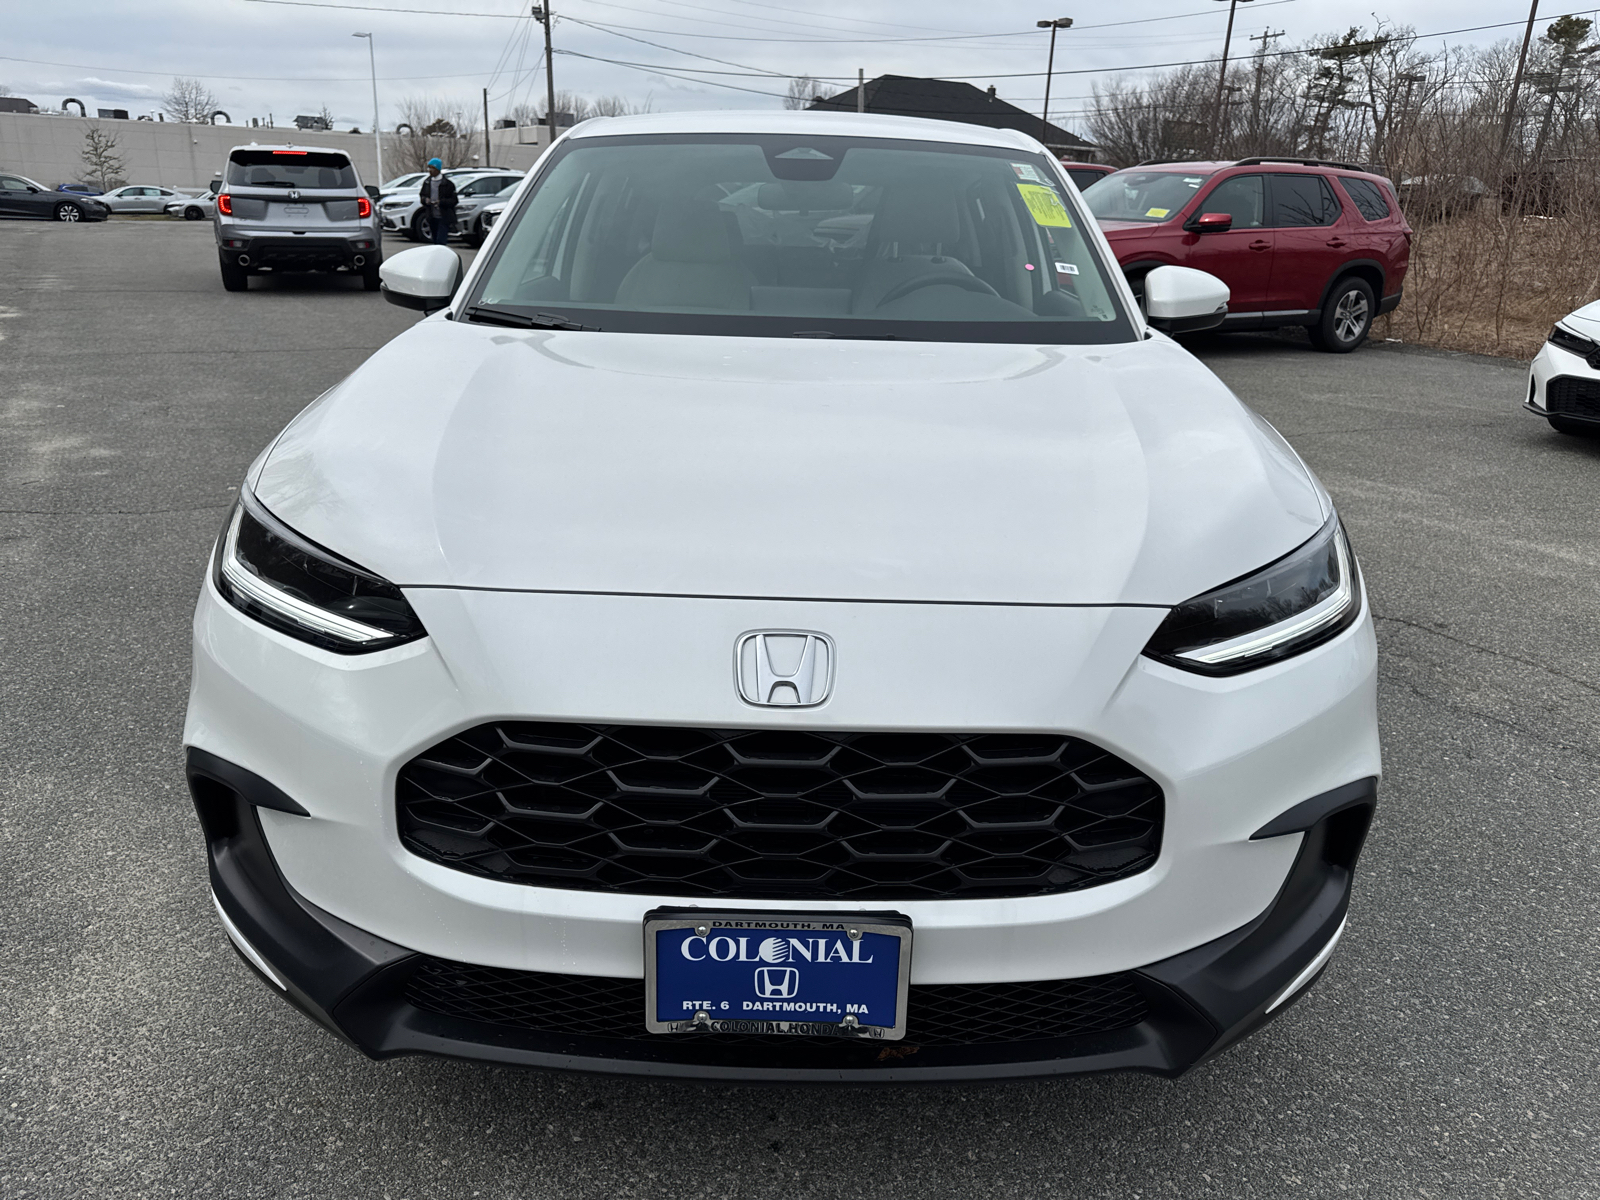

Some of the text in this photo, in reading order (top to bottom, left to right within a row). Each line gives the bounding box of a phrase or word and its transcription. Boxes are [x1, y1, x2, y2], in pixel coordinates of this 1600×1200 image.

[712, 921, 816, 930] DARTMOUTH,
[680, 936, 874, 964] COLONIAL
[682, 1000, 869, 1014] RTE. 6 DARTMOUTH, MA
[711, 1021, 784, 1033] COLONIAL
